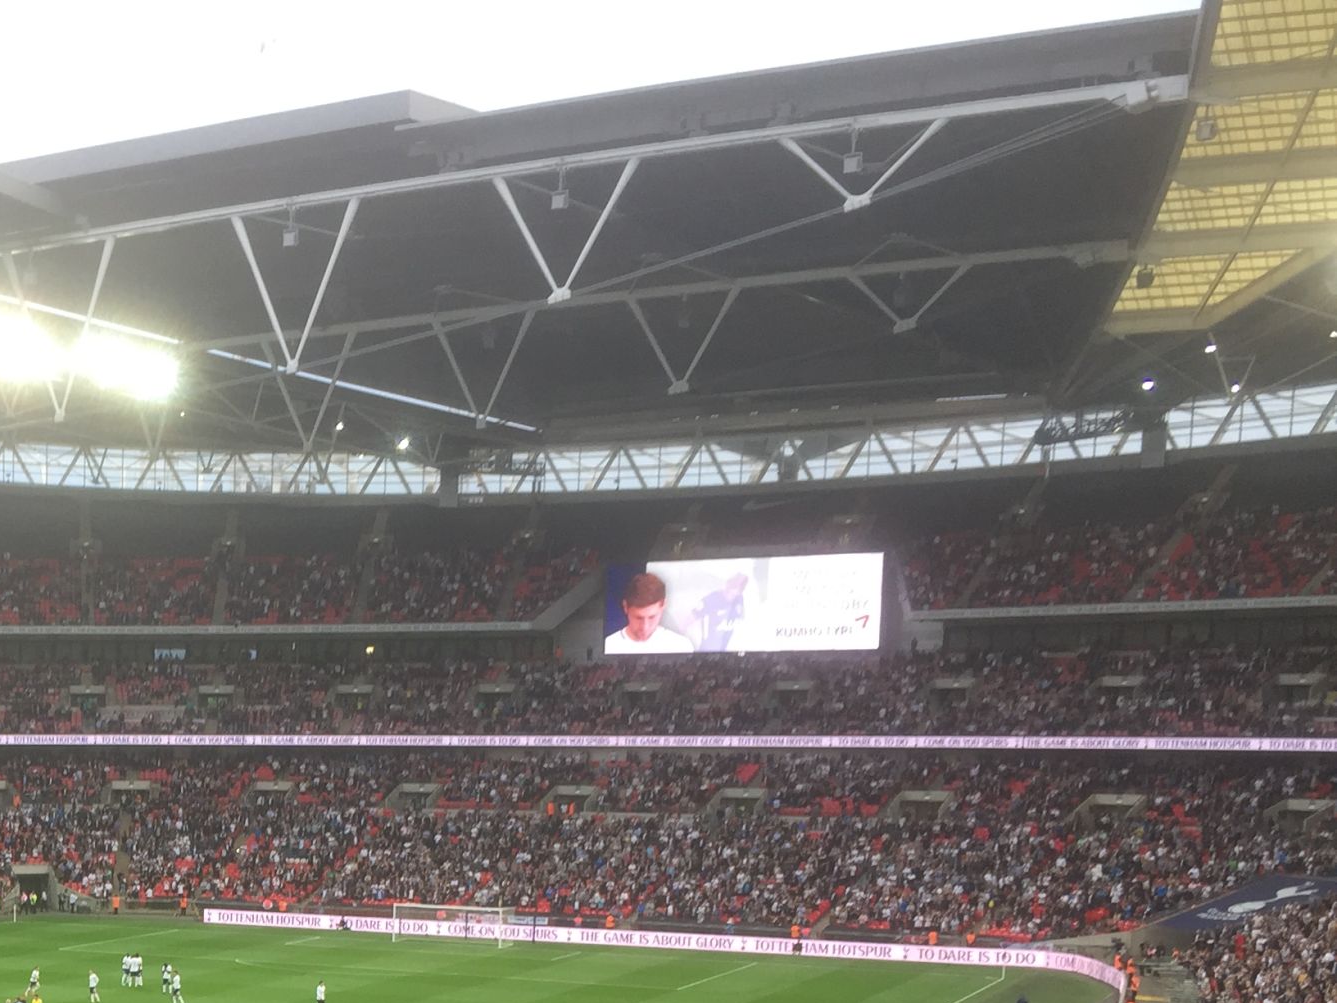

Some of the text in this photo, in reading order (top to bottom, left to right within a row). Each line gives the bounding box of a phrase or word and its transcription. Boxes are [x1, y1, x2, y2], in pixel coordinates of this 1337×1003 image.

[218, 912, 321, 927] TOTTENHAM HOTSPUR
[355, 919, 382, 930] DARE
[385, 920, 395, 931] IS
[414, 922, 428, 933] DO
[447, 924, 475, 936] COME
[479, 926, 495, 937] ON
[580, 931, 734, 949] THE GAME IS ABOUT GLORY
[755, 939, 892, 958] TOTTEHAM HOTSPUR
[918, 948, 1036, 964] TO DARE IS TO DO
